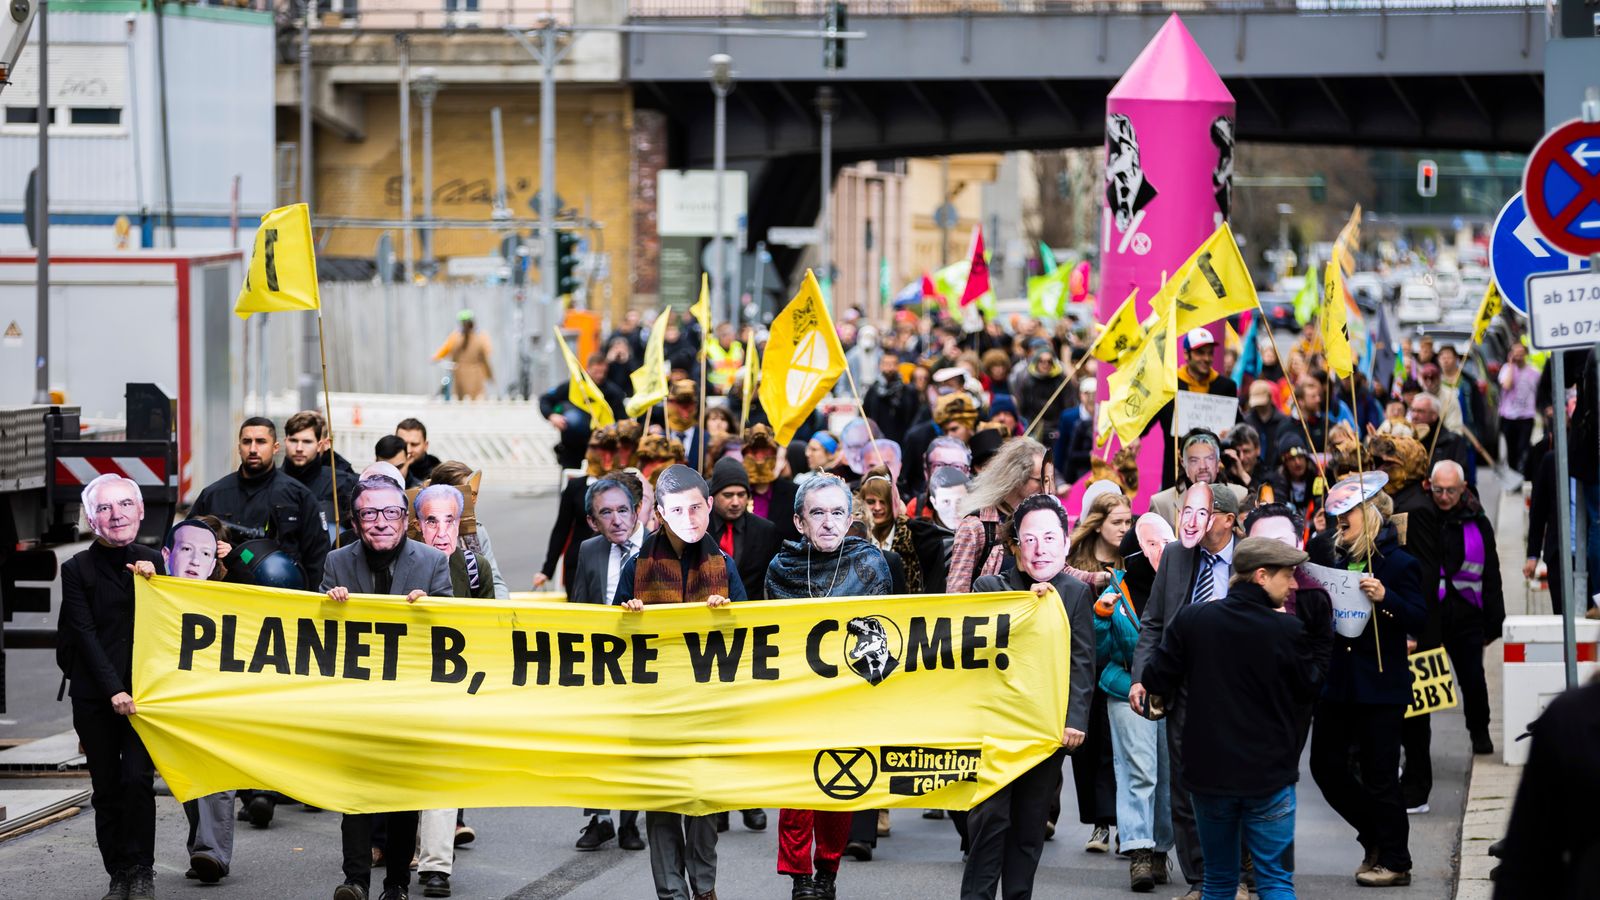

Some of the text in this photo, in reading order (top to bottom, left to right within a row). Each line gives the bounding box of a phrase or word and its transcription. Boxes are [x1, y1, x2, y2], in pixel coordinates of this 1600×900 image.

[1543, 290, 1562, 305] ab
[1551, 320, 1600, 337] ab 07:
[178, 613, 408, 681] PLANET
[430, 625, 486, 695] B,
[512, 630, 659, 687] HERE
[683, 624, 780, 683] WE
[1406, 681, 1453, 712] BBY
[885, 748, 982, 771] extinction
